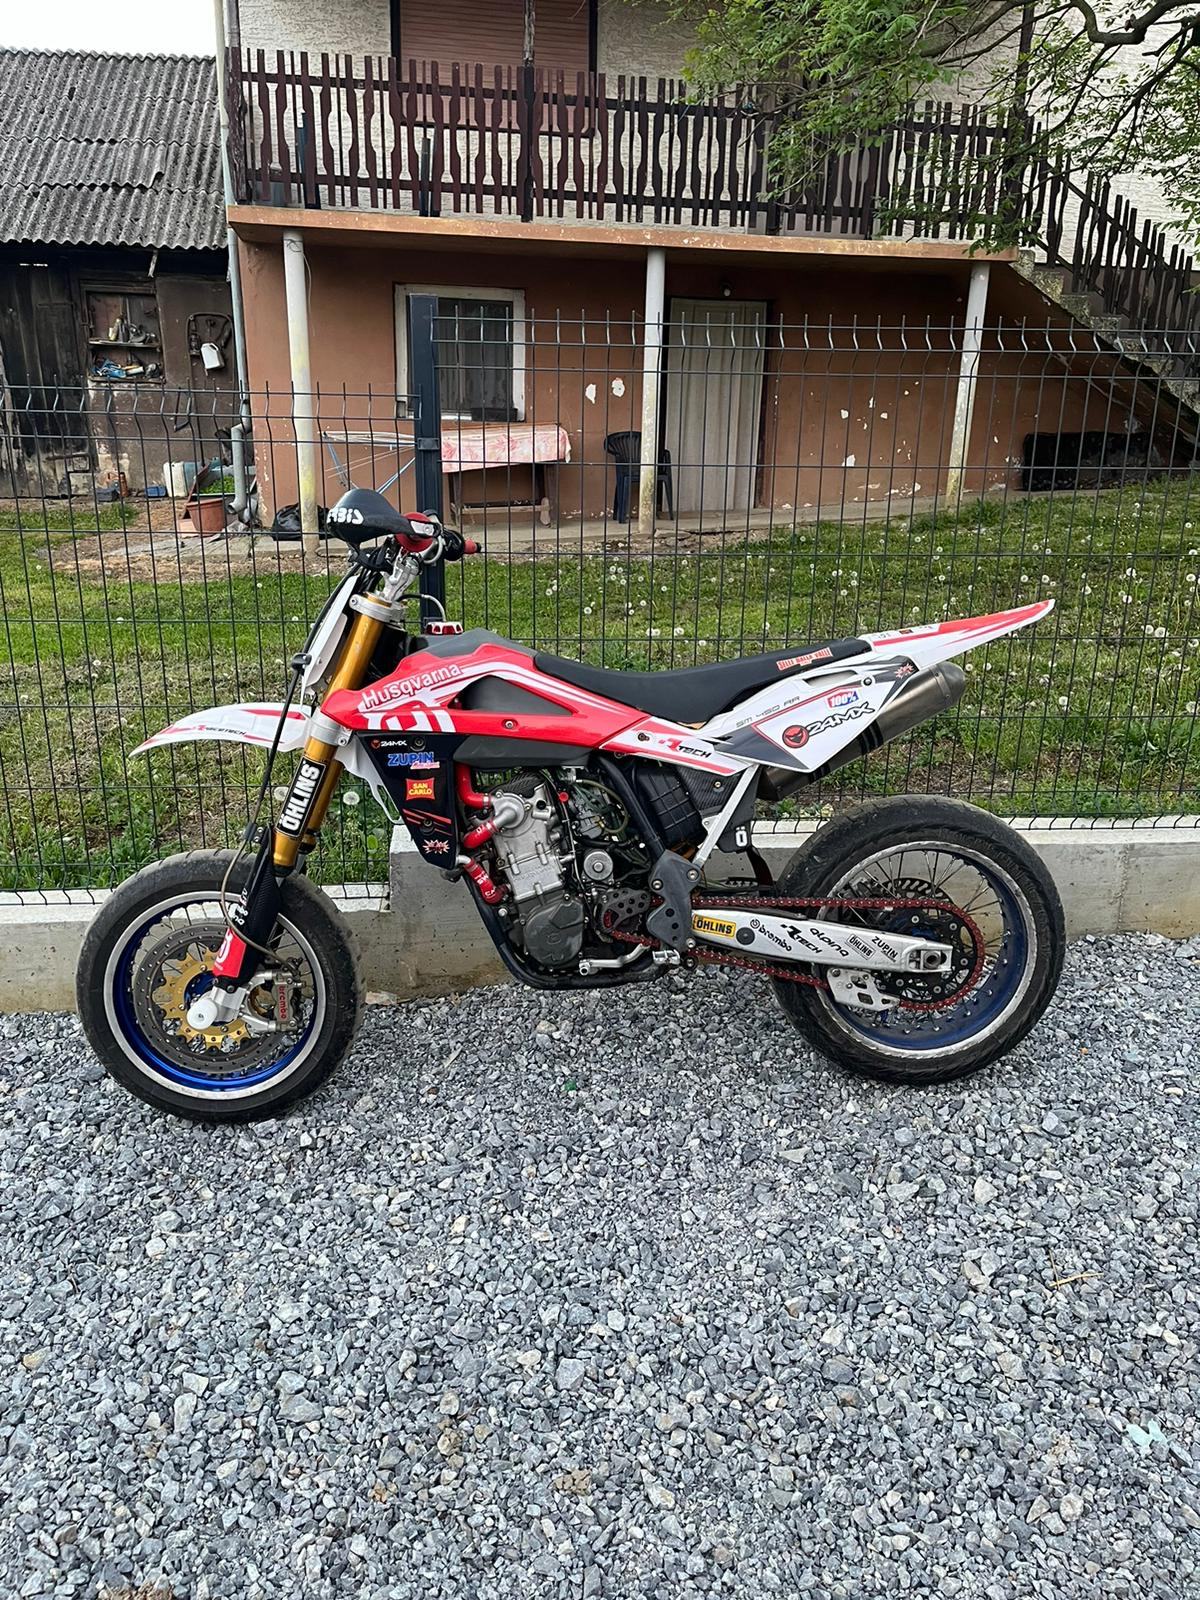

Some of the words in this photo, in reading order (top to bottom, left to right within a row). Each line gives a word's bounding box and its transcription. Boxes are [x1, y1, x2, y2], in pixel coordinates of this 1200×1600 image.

[361, 664, 461, 709] Husqvarna
[831, 691, 859, 706] 100%
[805, 701, 875, 737] 24MX
[387, 752, 434, 767] ZUPIN
[279, 763, 320, 831] ÖHLINS
[408, 788, 432, 796] CARLO
[758, 924, 792, 952] brembo
[871, 935, 899, 959] ZUPIN
